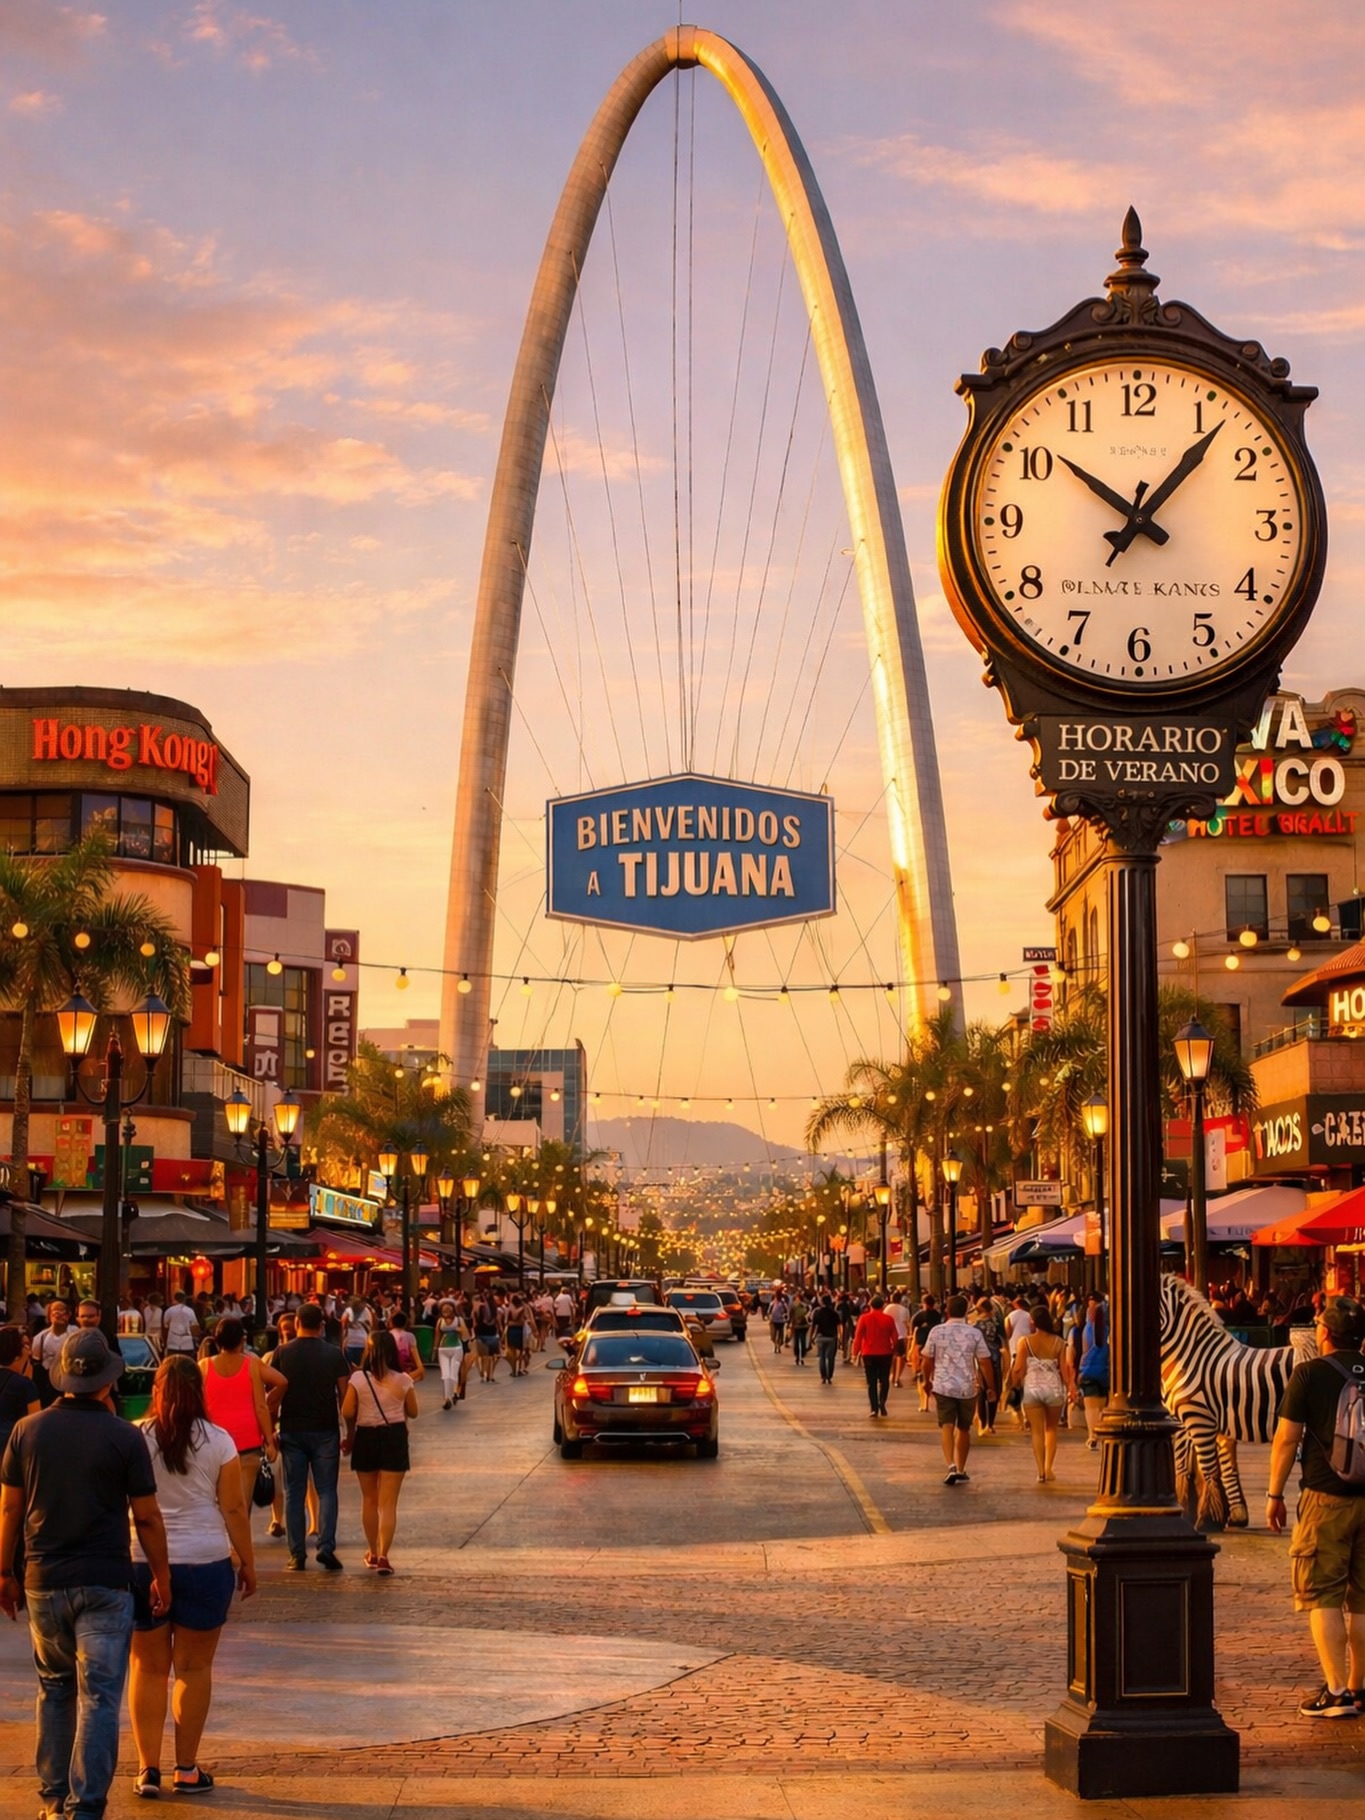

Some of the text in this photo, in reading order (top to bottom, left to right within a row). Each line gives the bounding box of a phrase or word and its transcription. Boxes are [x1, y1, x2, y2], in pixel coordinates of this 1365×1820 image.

[1066, 399, 1093, 433] 11
[1121, 383, 1157, 417] 12
[1193, 401, 1206, 434] 1
[1019, 446, 1053, 481] 10
[1234, 447, 1257, 482] 2
[999, 503, 1024, 539] 9
[1254, 509, 1278, 542] 3
[1018, 564, 1044, 600] 8
[1233, 567, 1259, 602] 4
[1067, 609, 1092, 646] 7
[1127, 627, 1152, 663] 6
[1192, 612, 1216, 648] 5
[32, 718, 135, 771] Hong
[1057, 723, 1222, 754] HORARIO
[1058, 759, 1220, 784] DE VERANO
[1216, 758, 1346, 806] XICO
[577, 805, 801, 851] BIENVENIDOS
[586, 851, 795, 897] A TIJUANA
